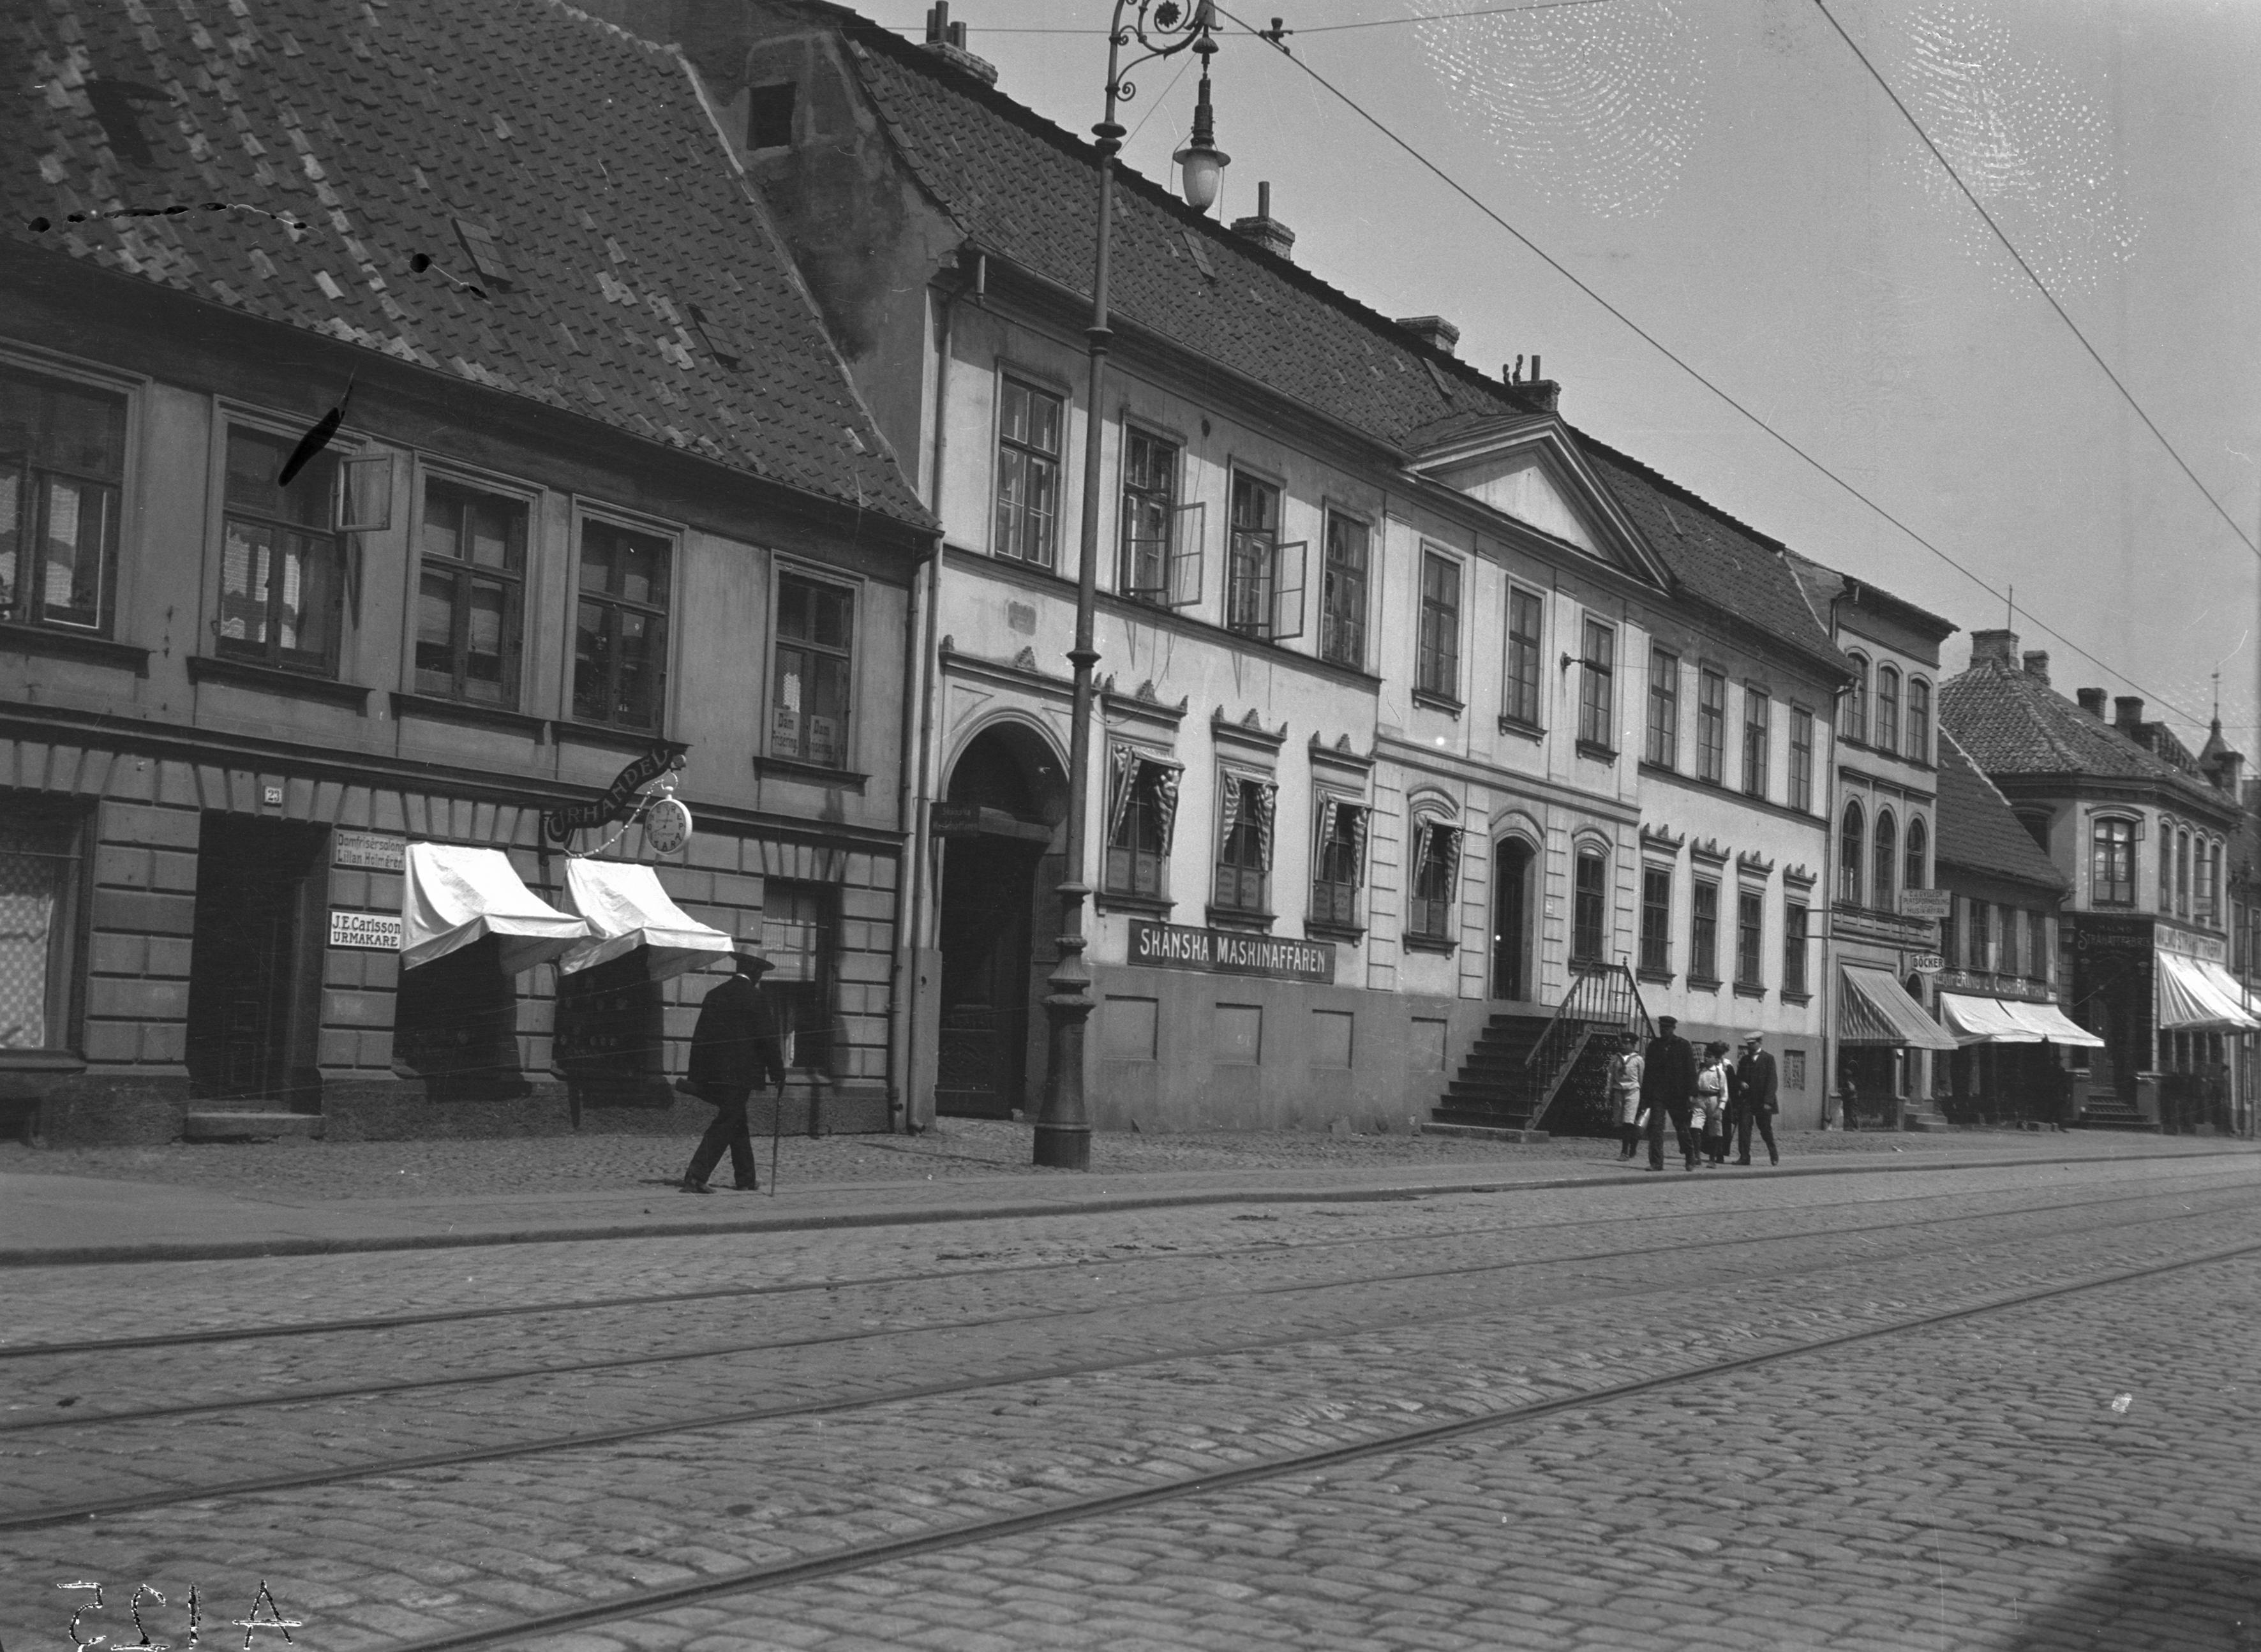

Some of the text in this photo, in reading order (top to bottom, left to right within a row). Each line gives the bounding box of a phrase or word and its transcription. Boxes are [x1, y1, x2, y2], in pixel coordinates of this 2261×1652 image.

[779, 713, 795, 731] Dam
[268, 789, 280, 802] 23
[549, 748, 669, 836] URHANDEL
[333, 932, 399, 947] URMAKARE
[1140, 926, 1325, 973] SKÅNSKA MASKINAFFÄREN
[1913, 955, 1944, 968] BÖCKER
